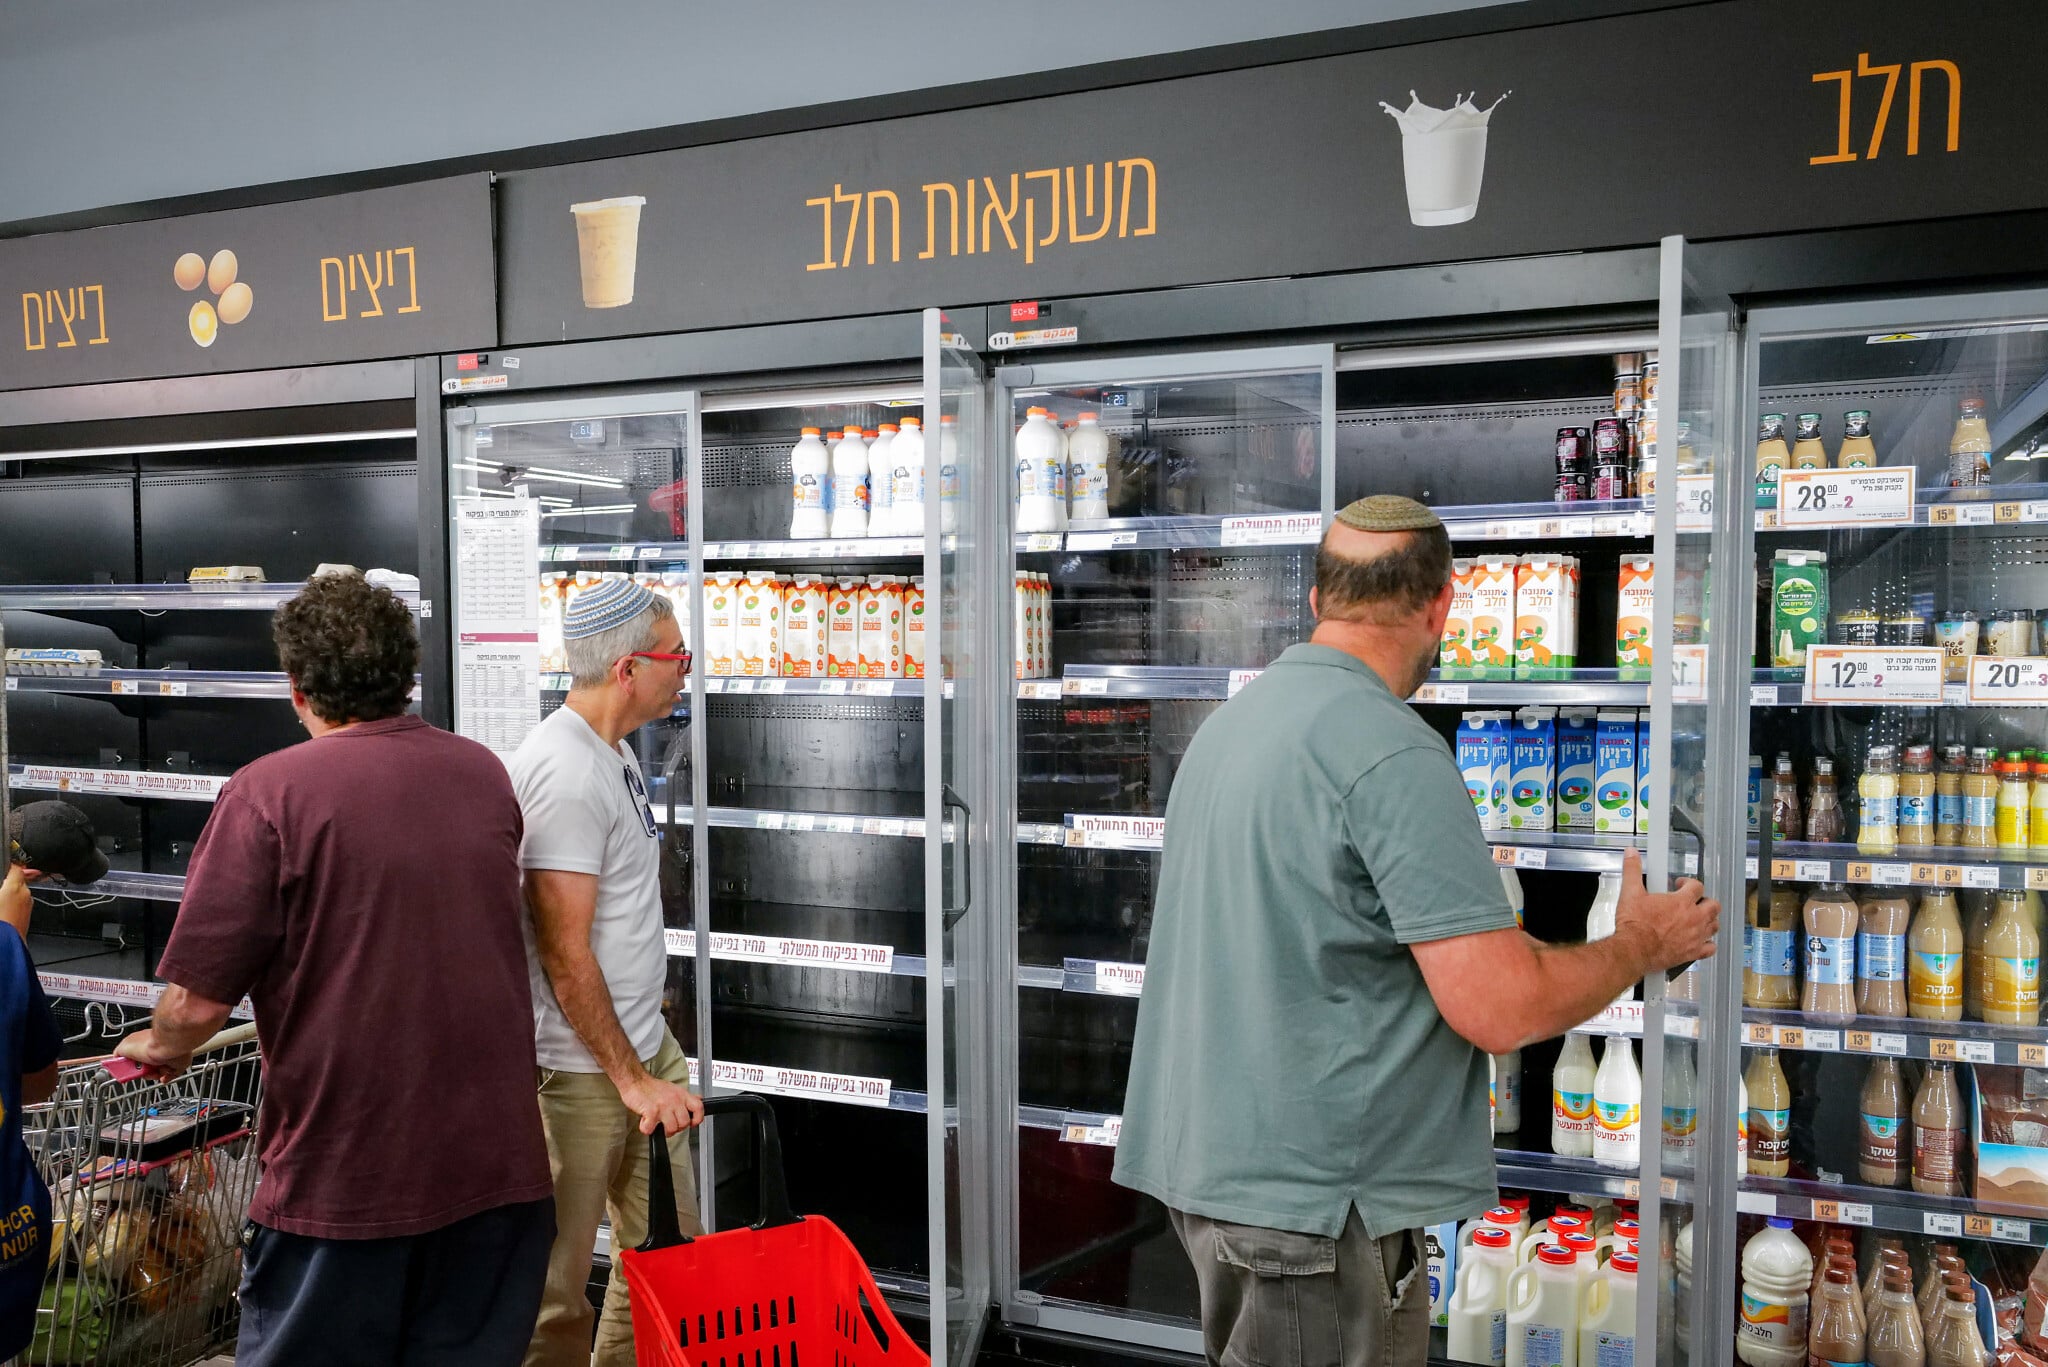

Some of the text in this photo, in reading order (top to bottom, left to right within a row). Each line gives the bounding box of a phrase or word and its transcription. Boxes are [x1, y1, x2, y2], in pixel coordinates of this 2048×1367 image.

[1809, 52, 1961, 166] חלב
[805, 156, 1157, 271] משקאות חלב
[321, 247, 421, 321] ביצים
[21, 283, 108, 350] ביצים
[1012, 307, 1036, 317] EC-16
[993, 336, 1009, 346] 111
[1477, 588, 1500, 596] תנובה
[1522, 588, 1546, 596] תנובה
[1484, 596, 1507, 607] חלב
[1529, 595, 1552, 606] חלב
[1873, 674, 1883, 687] 2
[102, 772, 130, 785] ממשלתי
[136, 774, 164, 790] ממשלתי
[165, 778, 193, 792] בפיקוח
[194, 779, 211, 791] מחיר
[742, 938, 766, 953] מחיר
[779, 940, 886, 963] מחיר בפיקוח ממשלתי
[1104, 966, 1143, 984] משלתי
[77, 978, 104, 993] ממשלתי
[106, 982, 129, 997] בפיקוח
[131, 985, 148, 997] מחיר
[1926, 984, 1955, 995] מוקה
[740, 1067, 764, 1082] מחיר
[777, 1070, 884, 1096] מחיר בפיקוח ממשלתי
[1556, 1119, 1582, 1131] מועשר
[1758, 1140, 1780, 1150] קפה
[1870, 1145, 1896, 1157] שוקו
[1425, 1246, 1438, 1254] טר
[1754, 1326, 1773, 1339] חלב
